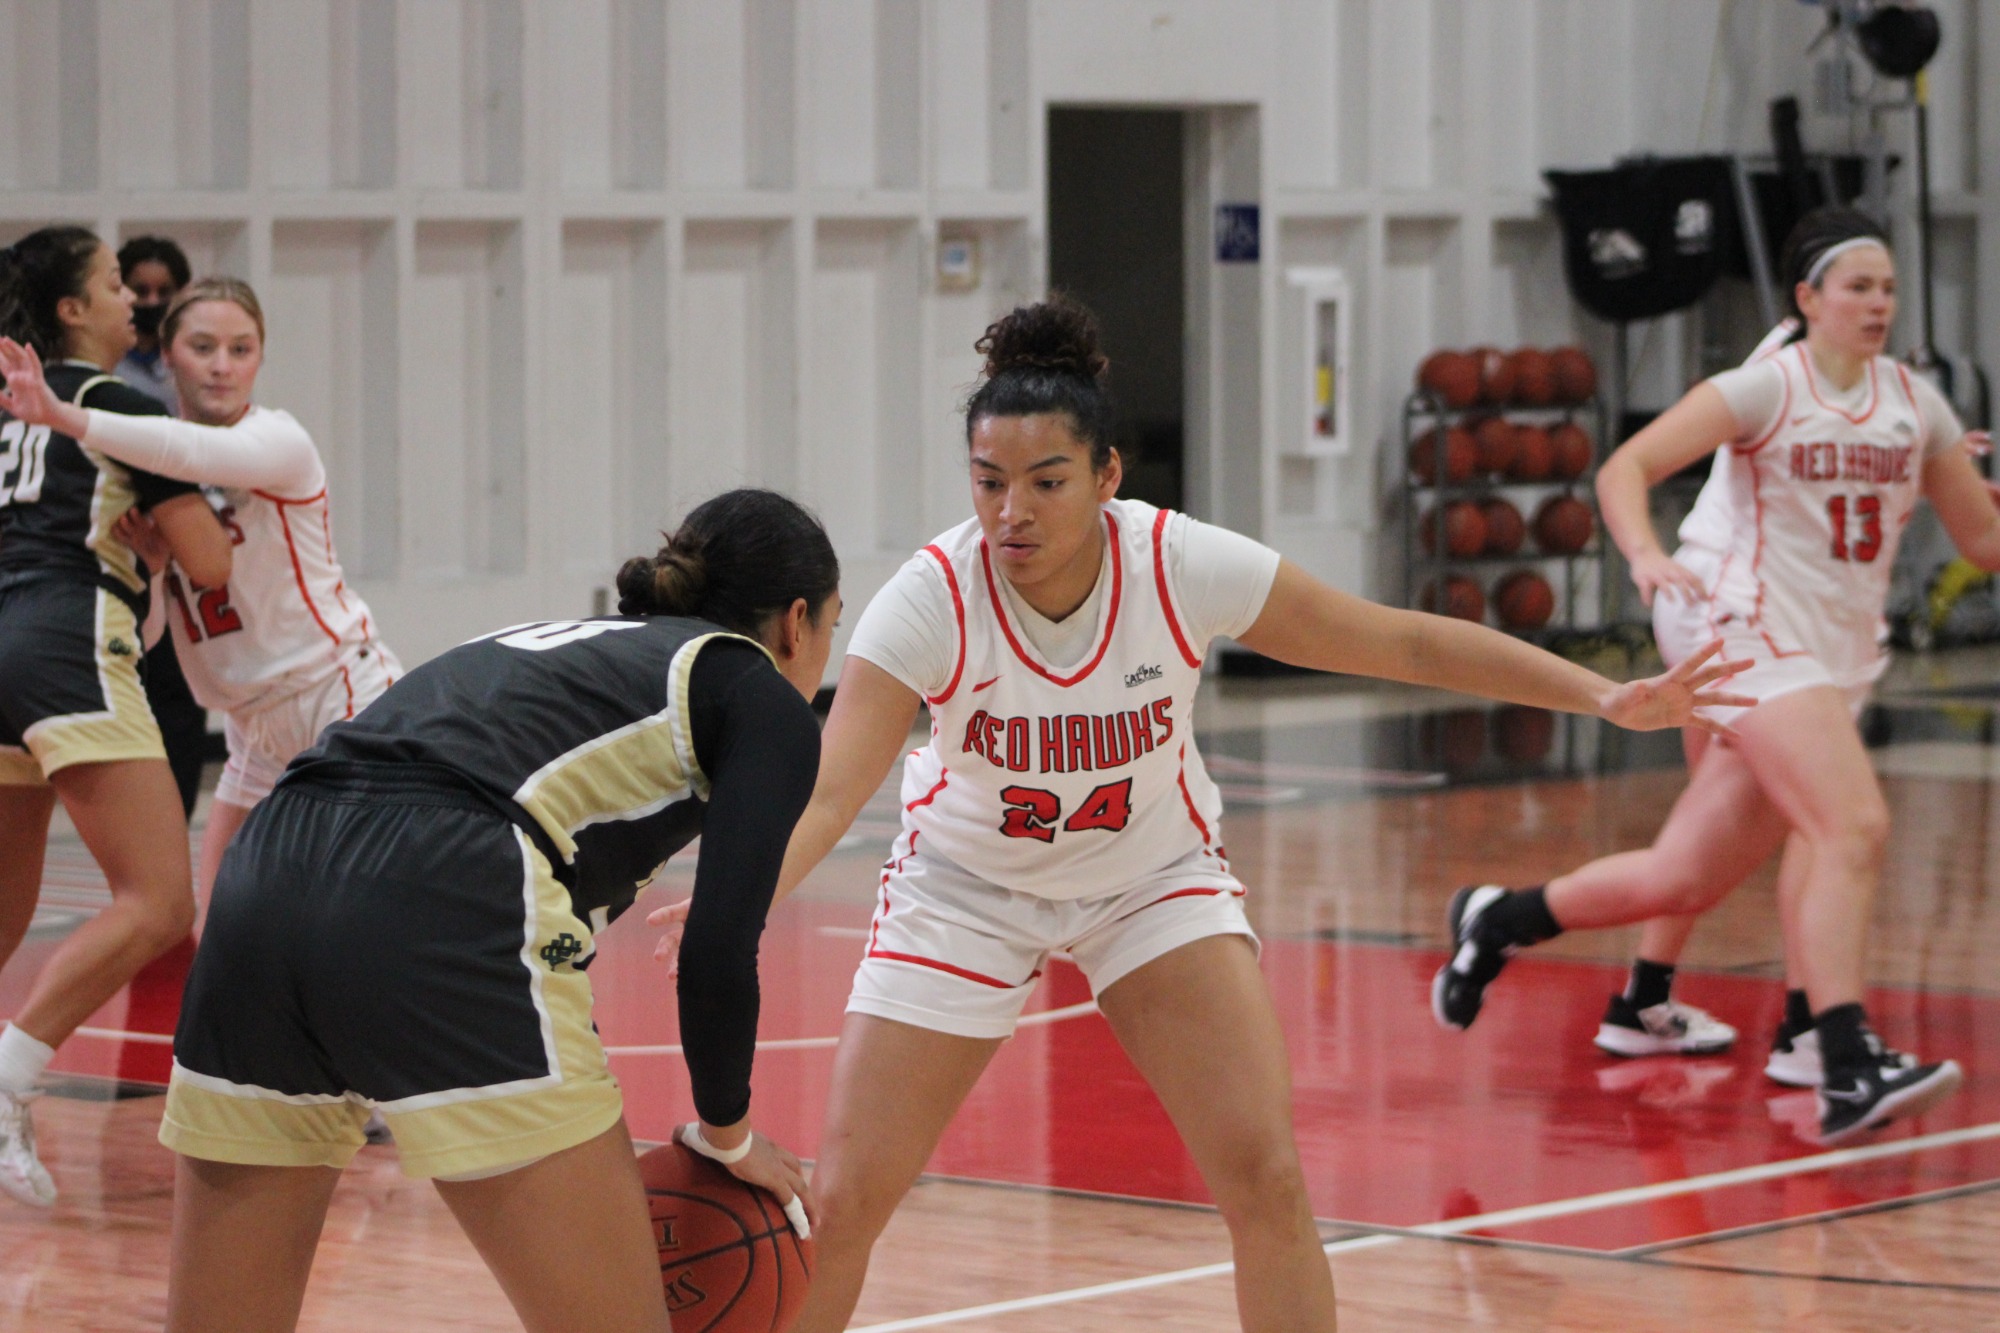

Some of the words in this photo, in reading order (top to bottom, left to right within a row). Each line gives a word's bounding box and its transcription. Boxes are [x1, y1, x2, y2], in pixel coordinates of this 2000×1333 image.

[0, 420, 51, 507] 20
[1790, 442, 1838, 482] RED
[1826, 494, 1882, 563] 13
[1142, 664, 1163, 679] PAC
[962, 709, 1030, 773] RED
[1038, 695, 1173, 773] HAWKS
[998, 776, 1133, 844] 24
